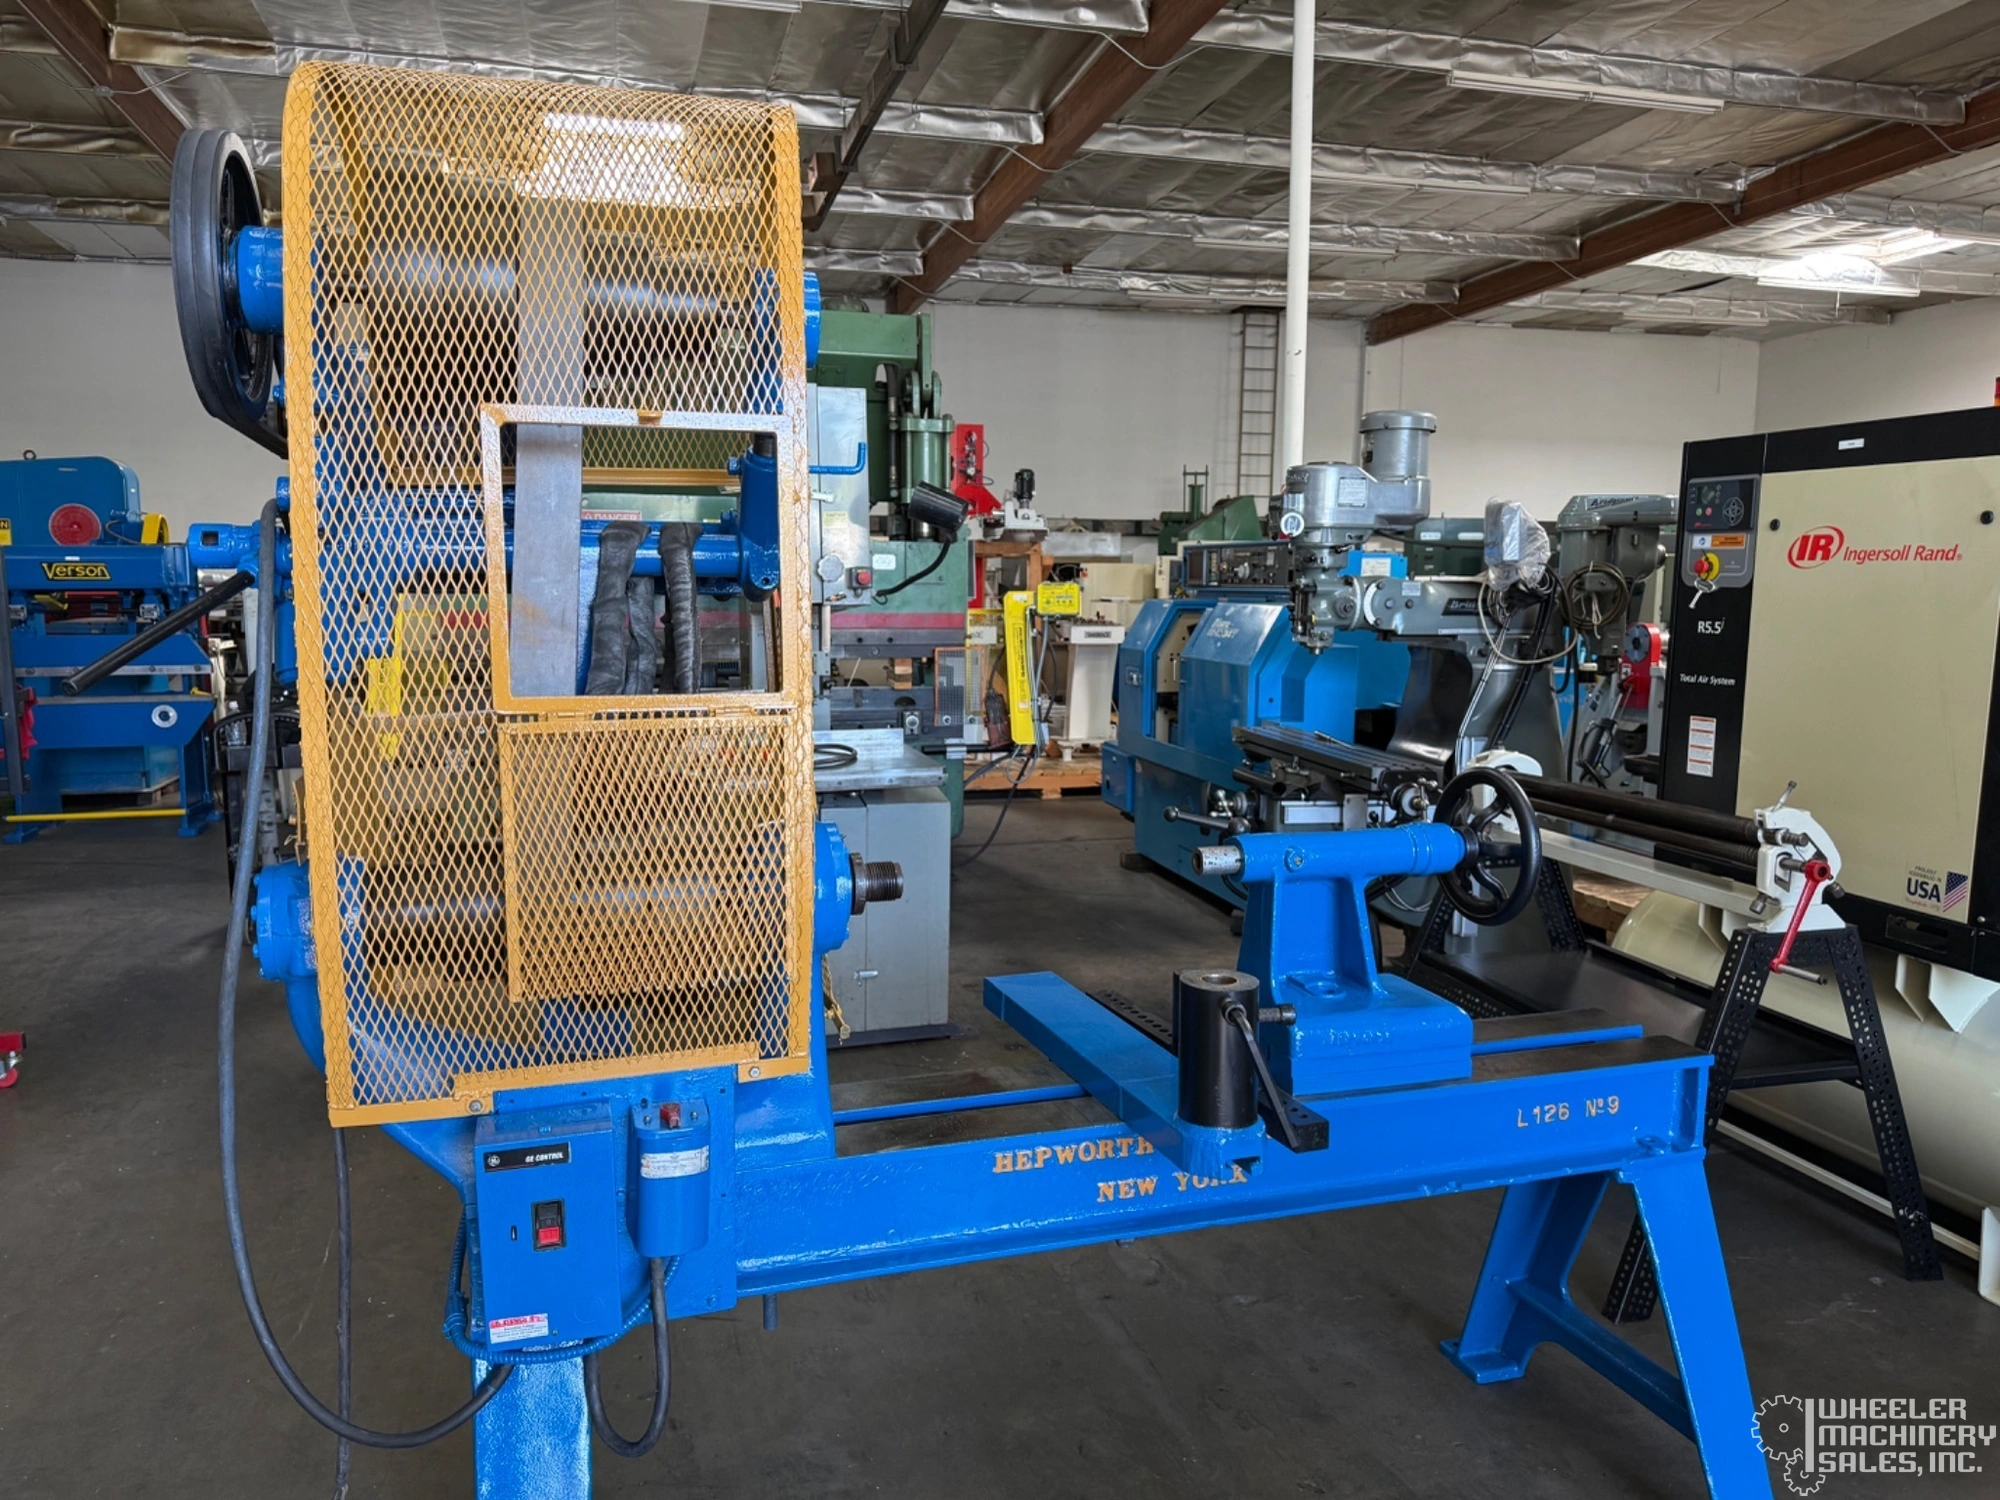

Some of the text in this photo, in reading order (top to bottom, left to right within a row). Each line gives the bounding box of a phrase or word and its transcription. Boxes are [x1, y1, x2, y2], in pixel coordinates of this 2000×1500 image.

[1843, 544, 1911, 565] Ingersoll
[41, 563, 111, 579] Verson
[1680, 673, 1736, 686] Total Air System
[1907, 877, 1941, 903] USA
[535, 1152, 564, 1162] CONTROL
[1096, 1163, 1248, 1203] NEW YOK
